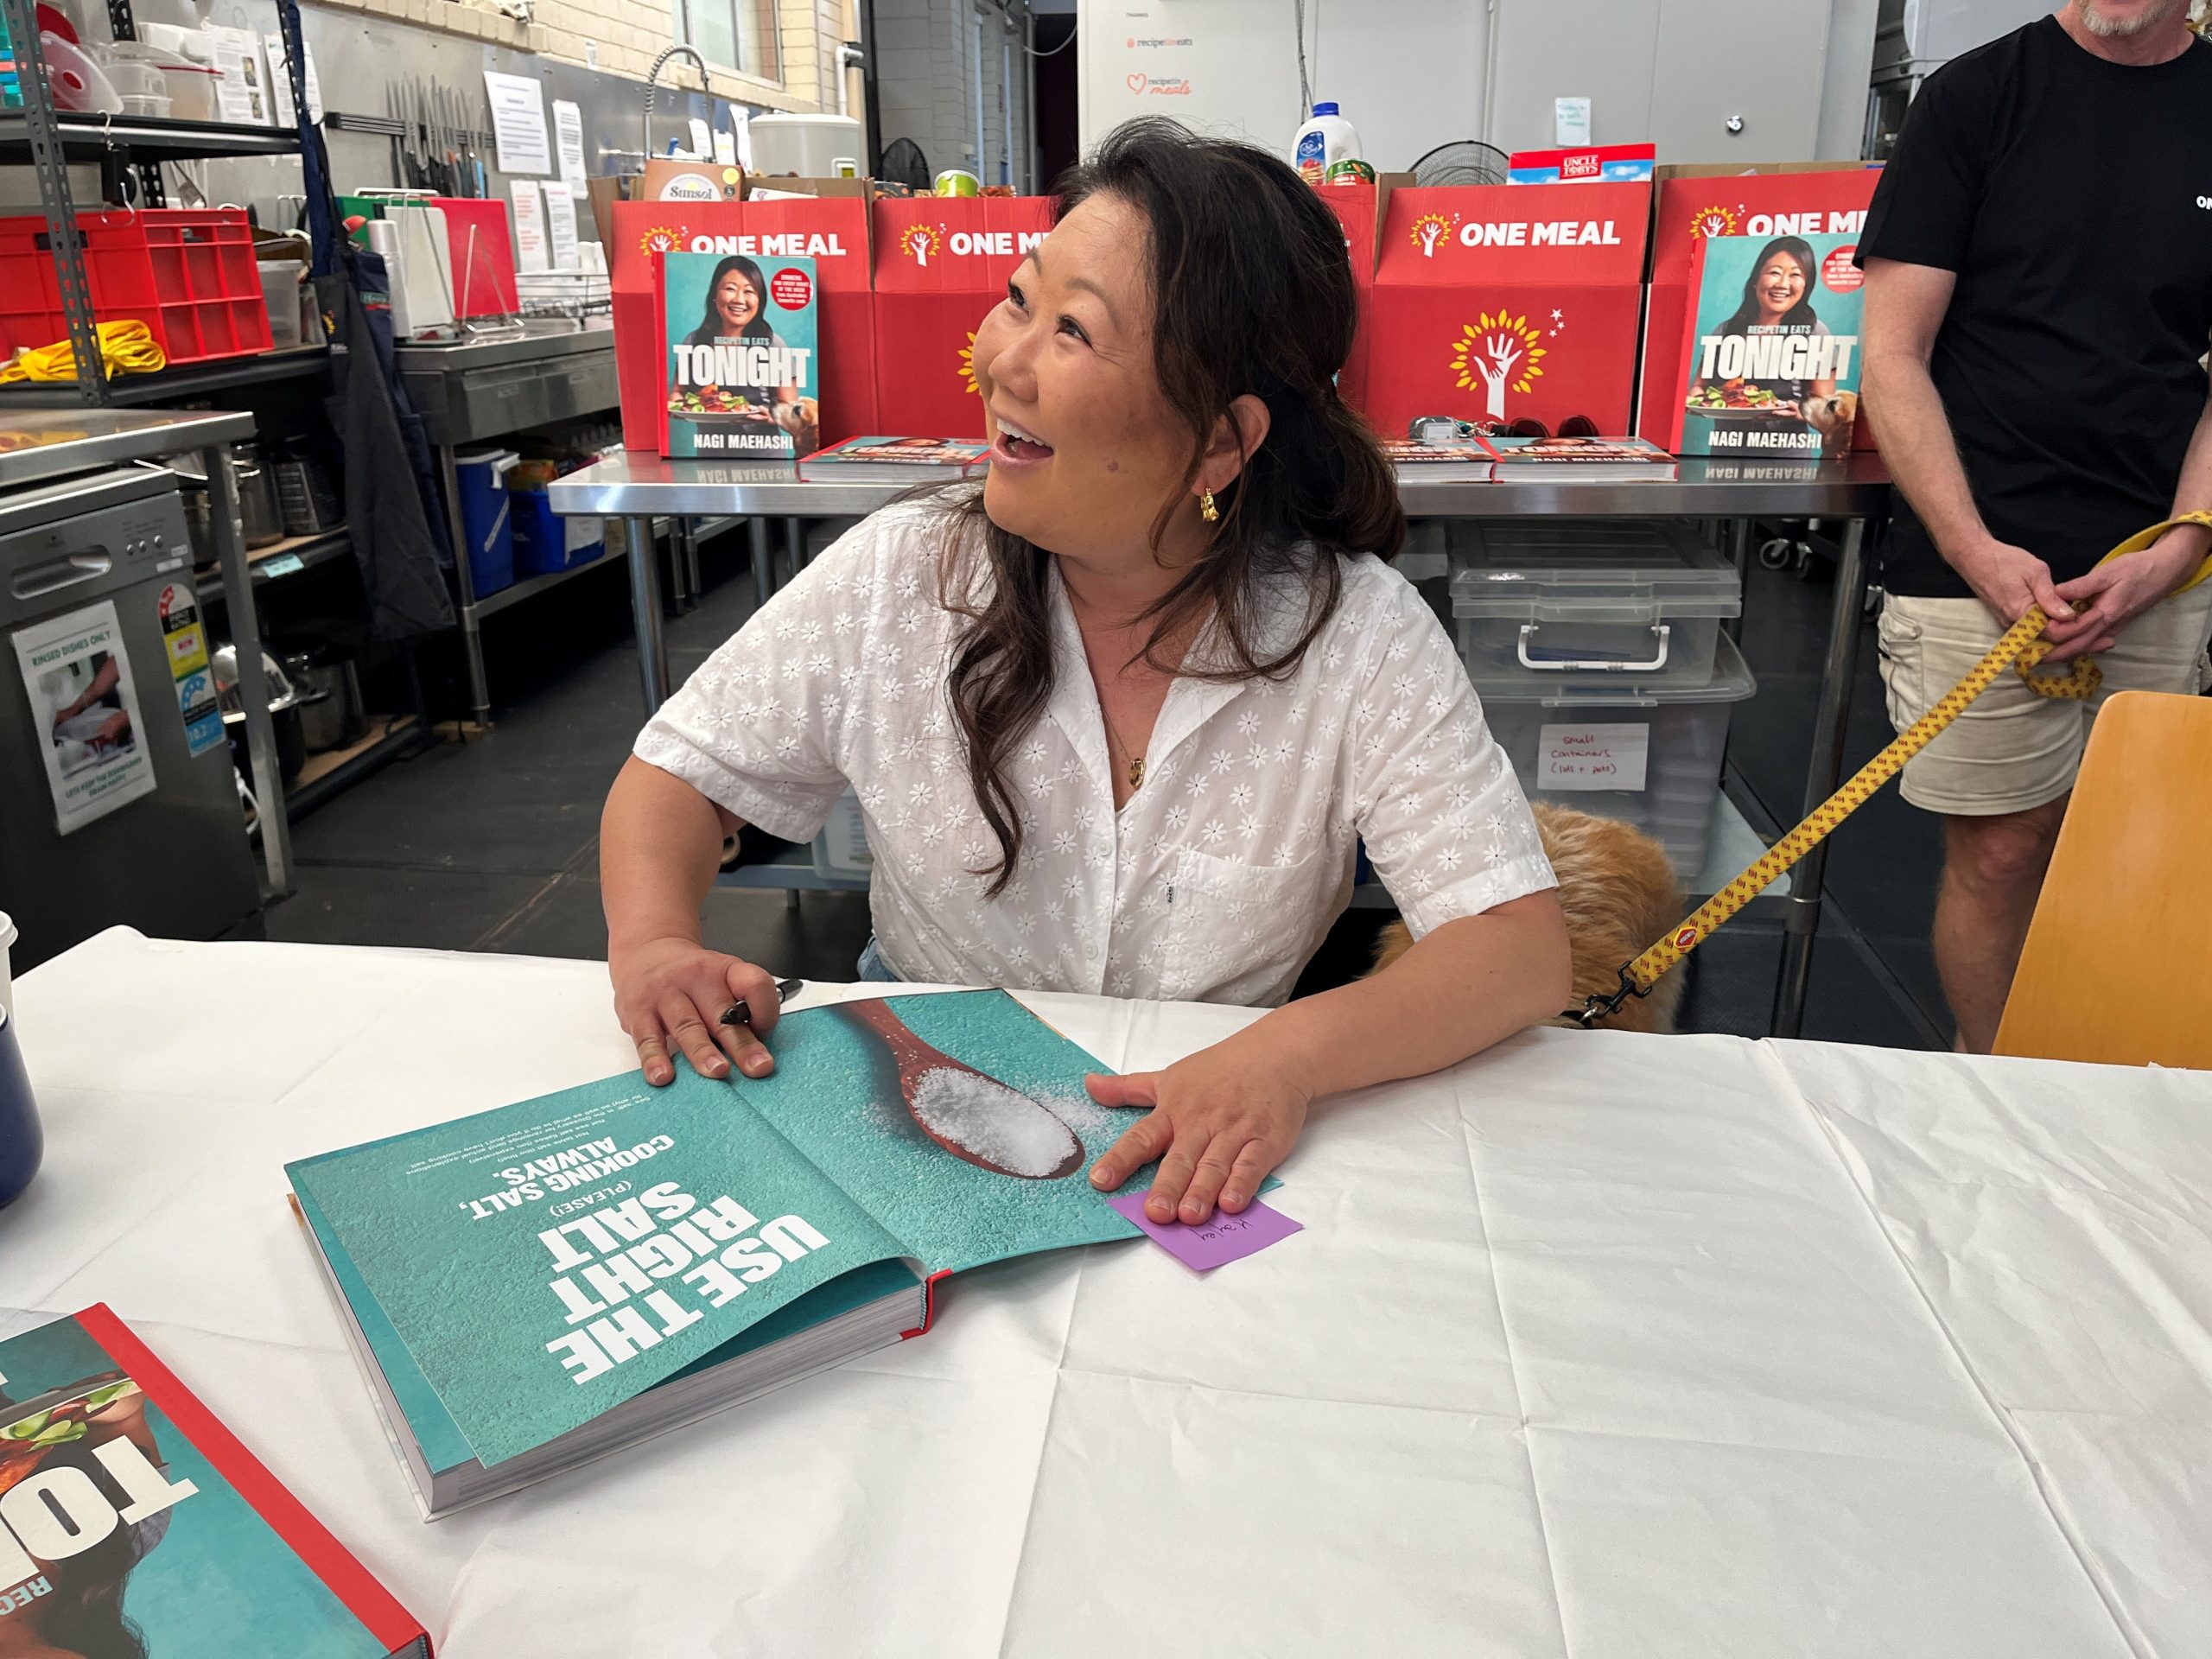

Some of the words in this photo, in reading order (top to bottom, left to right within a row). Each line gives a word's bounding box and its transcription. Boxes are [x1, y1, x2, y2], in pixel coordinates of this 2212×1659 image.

[1562, 165, 1599, 176] TOBYS
[1563, 155, 1599, 166] UNCLE
[670, 185, 712, 200] Sunsol
[1460, 222, 1528, 247] ONE
[1530, 221, 1621, 246] MEAL
[1746, 213, 1822, 237] ONE
[690, 235, 757, 256] ONE
[761, 233, 847, 257] MEAL
[950, 232, 1014, 256] ONE
[751, 337, 771, 346] EATS
[1747, 325, 1789, 334] RECIPETIN
[1789, 325, 1811, 334] EATS
[673, 344, 810, 388] TONIGHT
[1700, 334, 1858, 381] TONIGHT
[694, 434, 724, 448] NAGI
[728, 435, 794, 449] MAEHASHI
[1708, 431, 1743, 447] NAGI
[1746, 432, 1822, 449] MAEHASHI
[90, 630, 110, 645] ONLY
[492, 1136, 618, 1185] ALWAYS.
[545, 1134, 674, 1193] COOKING
[459, 1182, 545, 1220] SALT,
[550, 1180, 632, 1217] (PLEASE!)
[537, 1181, 696, 1274] SALT
[549, 1195, 760, 1325] RIGHT
[682, 1214, 831, 1309] USE
[546, 1288, 705, 1385] THE
